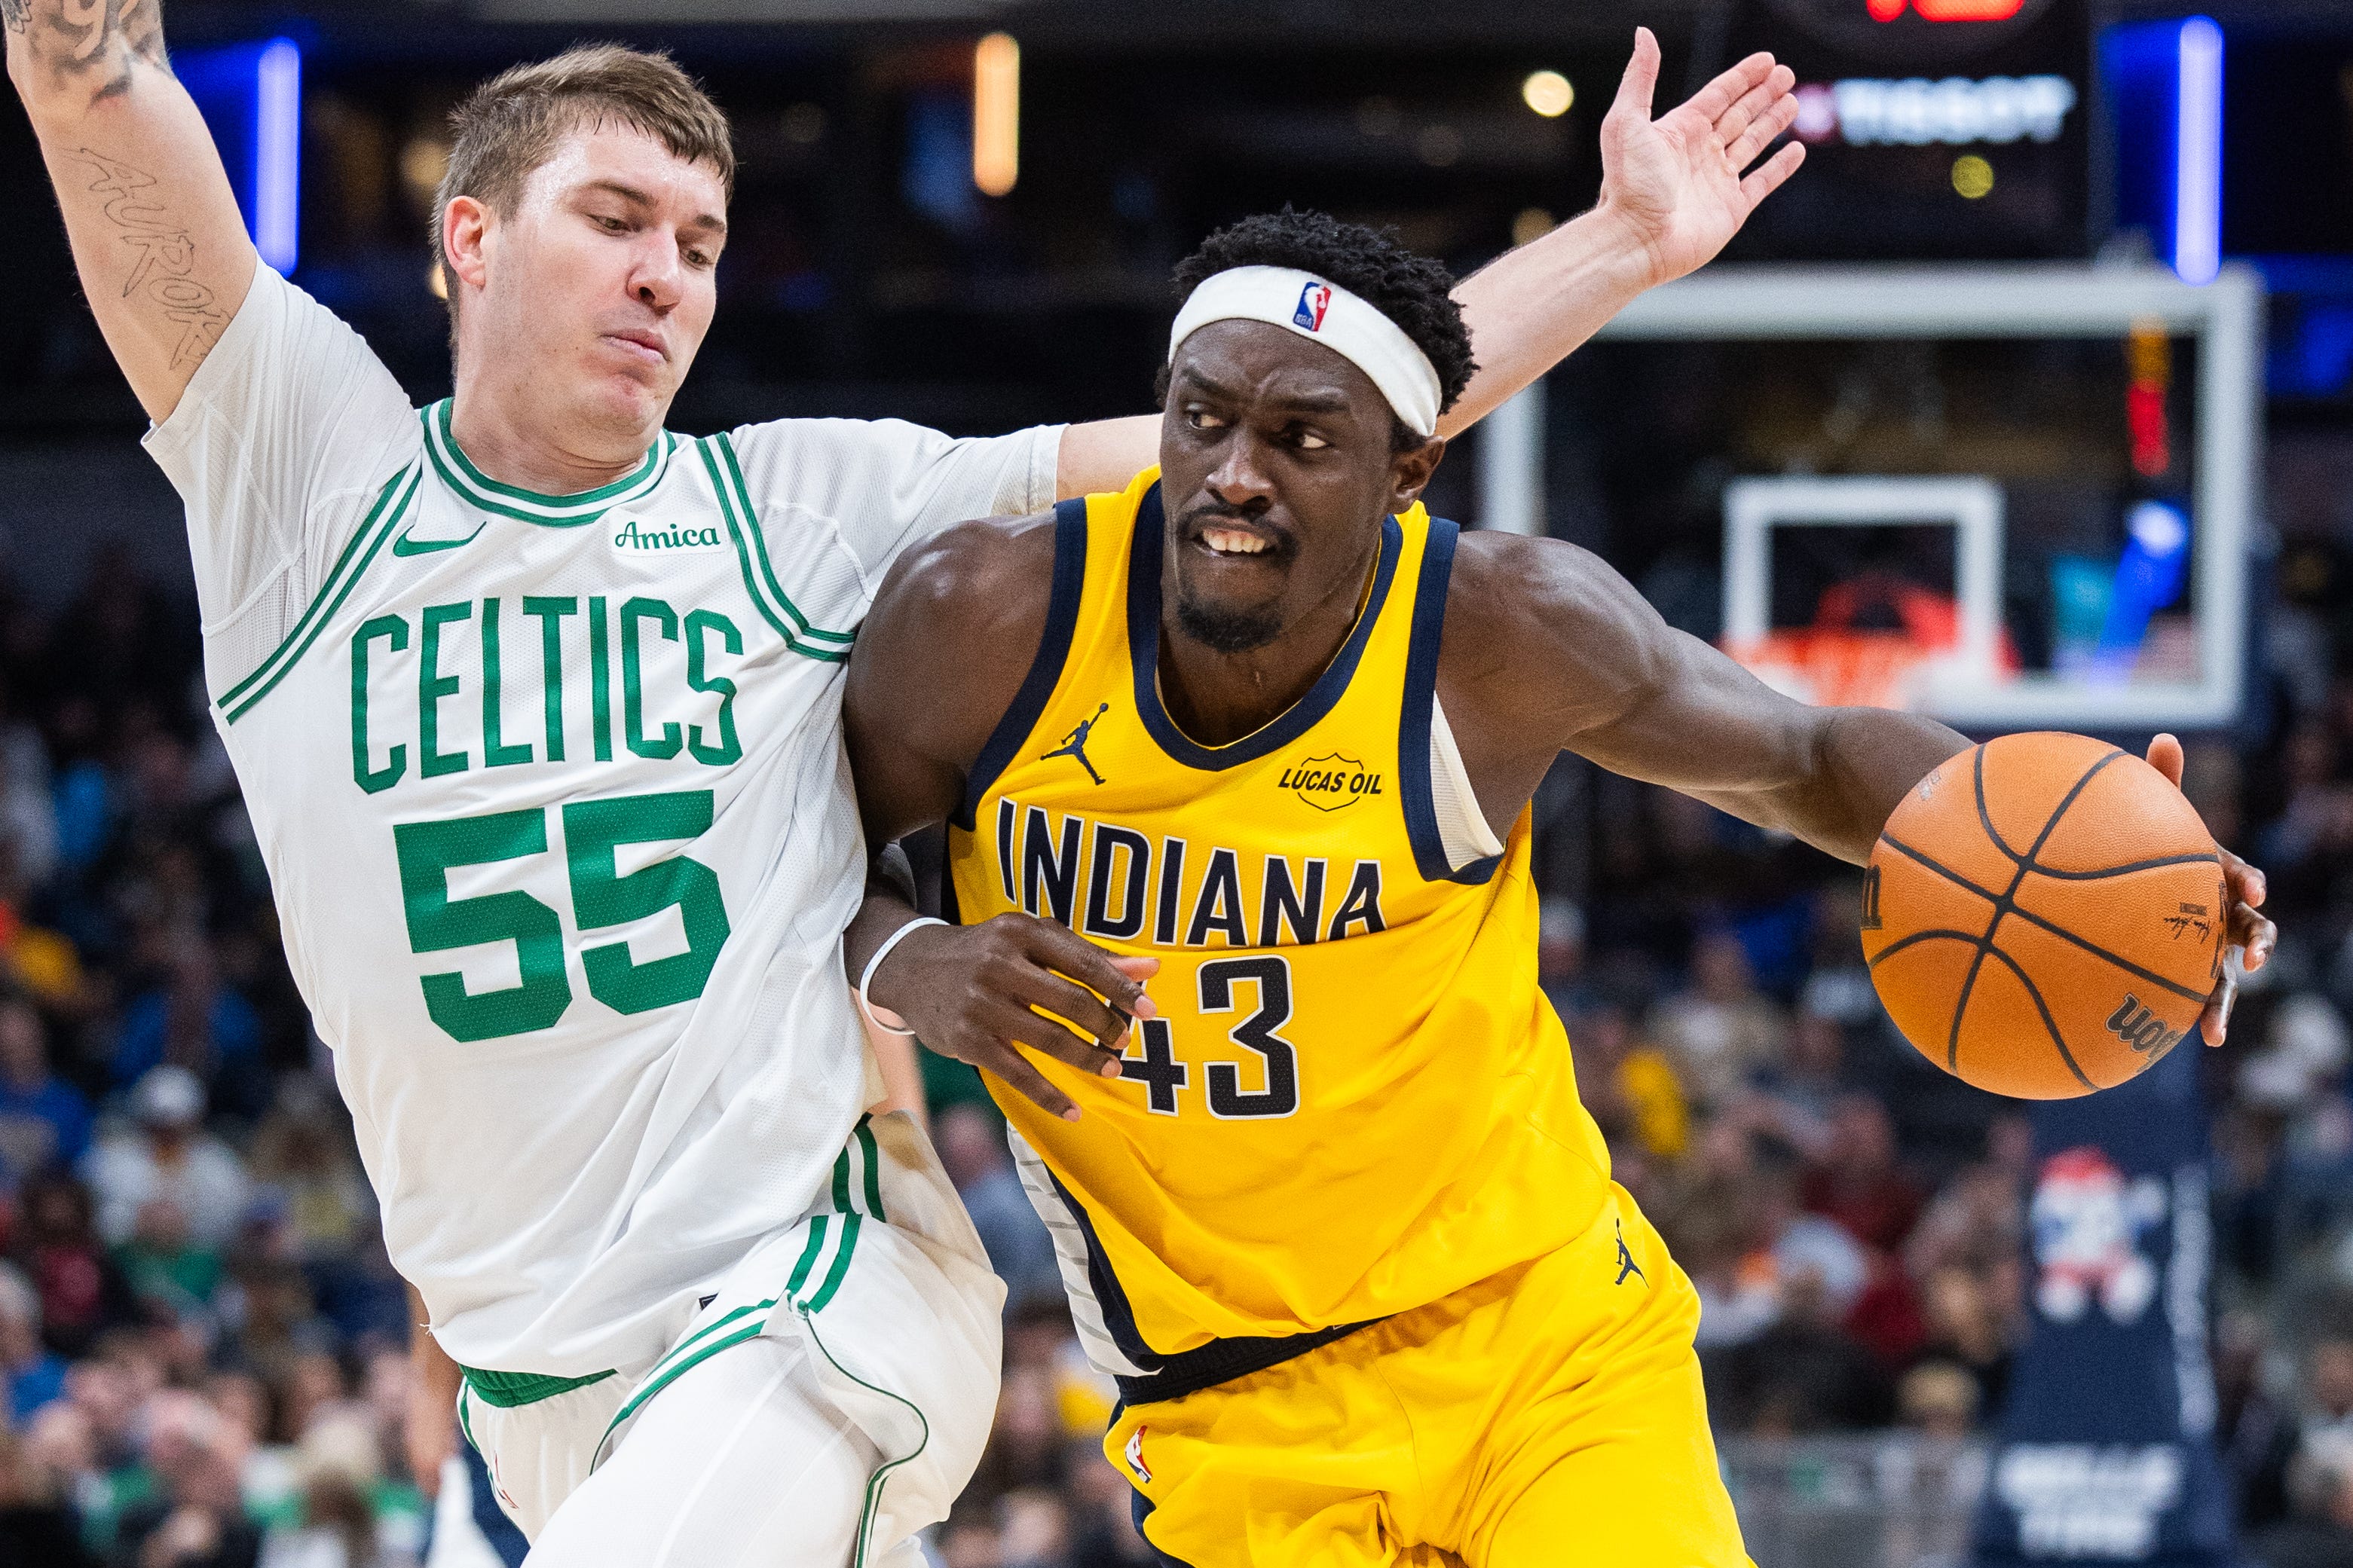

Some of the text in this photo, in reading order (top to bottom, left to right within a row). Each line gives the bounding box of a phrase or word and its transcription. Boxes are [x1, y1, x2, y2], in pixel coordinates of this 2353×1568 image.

[614, 521, 721, 549] Amica
[350, 595, 744, 796] CELTICS
[1277, 769, 1382, 794] LUCAS OIL
[393, 790, 732, 1043] 55
[996, 796, 1388, 948] INDIANA
[1094, 954, 1300, 1120] 43
